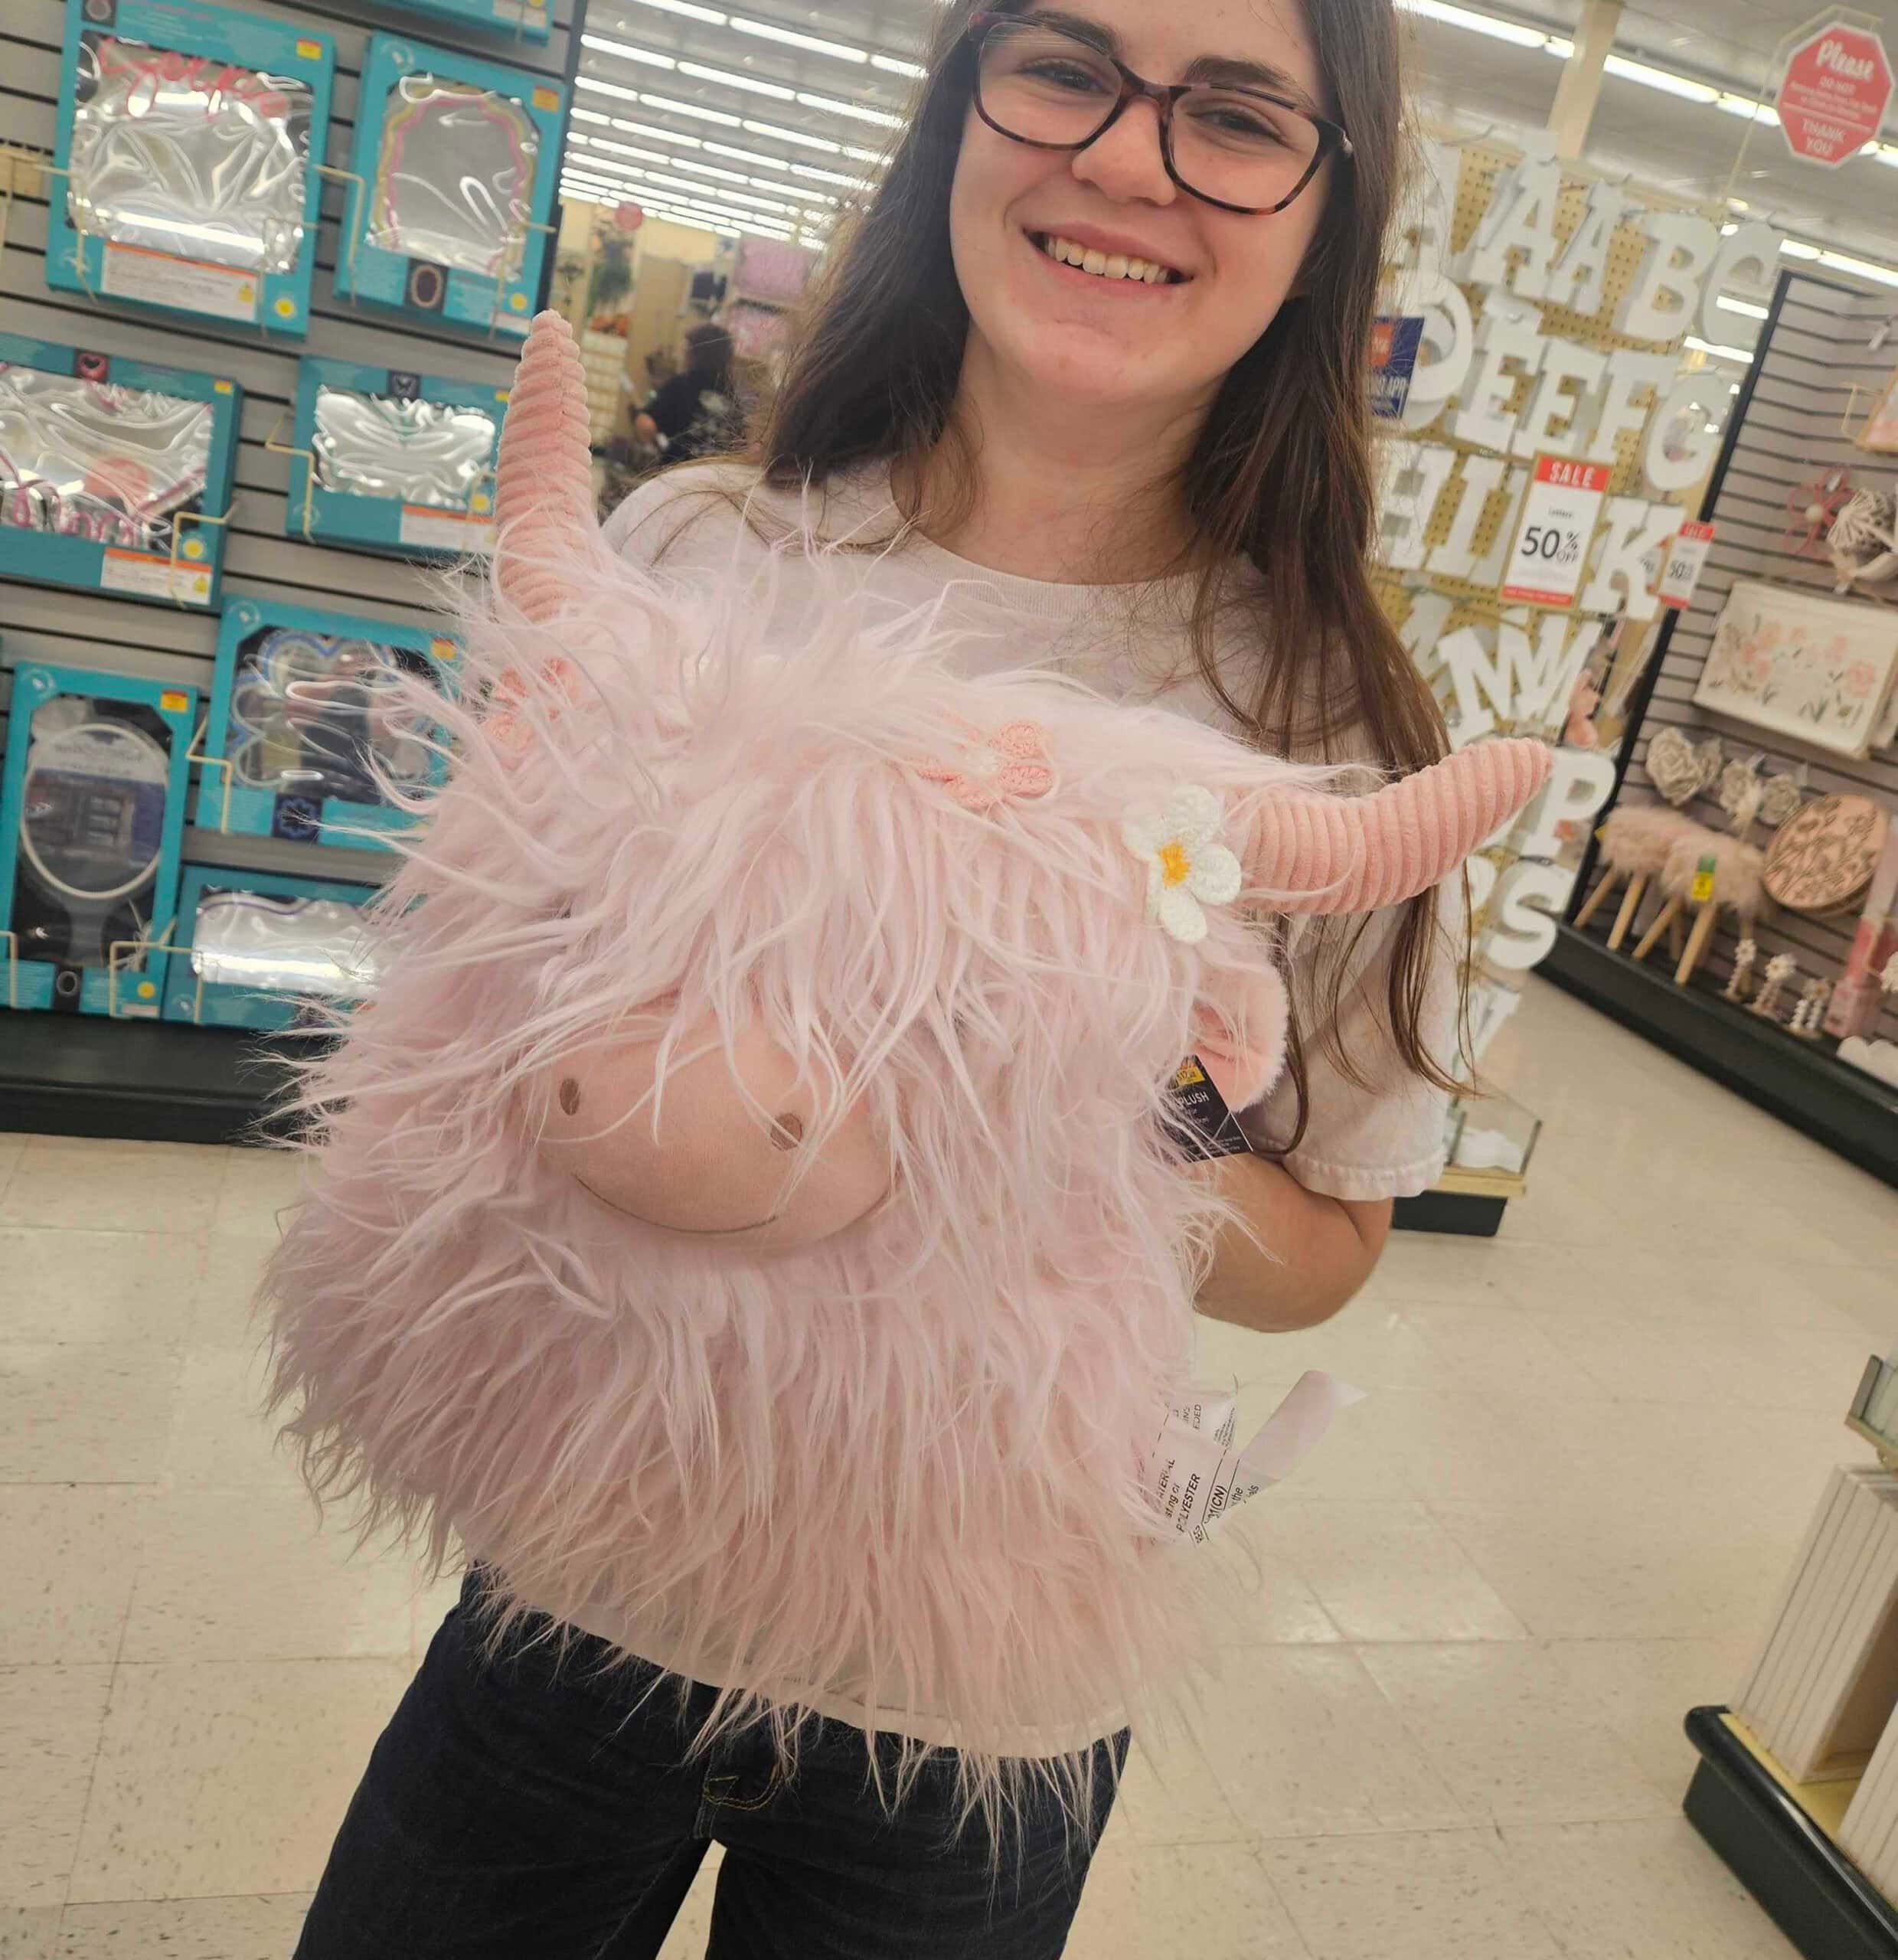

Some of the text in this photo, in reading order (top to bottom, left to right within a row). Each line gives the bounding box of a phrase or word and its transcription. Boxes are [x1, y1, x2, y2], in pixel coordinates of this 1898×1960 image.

[1815, 39, 1875, 83] Please
[1802, 118, 1846, 143] THANK
[1806, 136, 1834, 155] YOU
[1623, 211, 1720, 341] B
[1455, 295, 1545, 453] E
[1514, 338, 1607, 459] E
[1589, 348, 1679, 464] F
[1549, 461, 1596, 488] SALE
[1557, 550, 1579, 564] OFF
[1580, 495, 1684, 621] K
[1520, 747, 1616, 858] P
[1485, 861, 1577, 969] S
